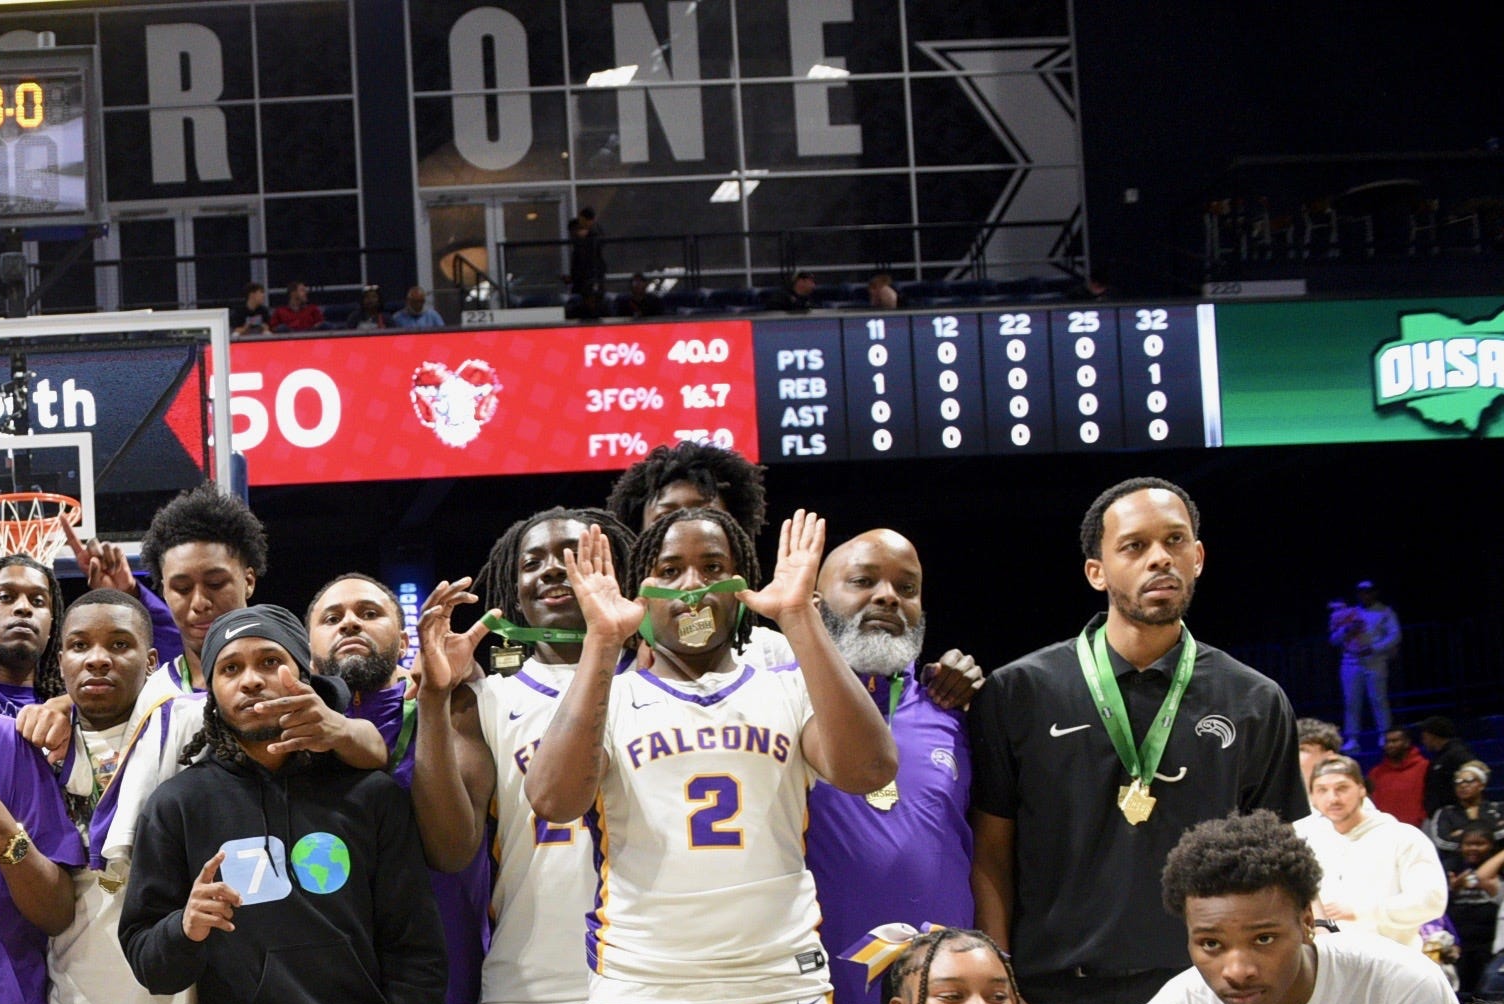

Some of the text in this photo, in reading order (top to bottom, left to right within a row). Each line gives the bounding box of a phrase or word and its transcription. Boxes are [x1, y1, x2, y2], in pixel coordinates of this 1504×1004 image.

[449, 0, 863, 170] ONE
[466, 310, 496, 325] 221
[866, 309, 1169, 340] 11 12 22 25 32
[585, 338, 729, 368] FG% 40.0
[777, 334, 1164, 371] PTS 0 0 0 0 0
[585, 383, 732, 412] 3FG% 16.7
[779, 362, 1161, 400] REB 1 0 0 0 1
[208, 369, 342, 452] 50
[781, 390, 1167, 427] AST 0 0 0 0 0
[588, 432, 648, 457] FT%
[782, 418, 1169, 456] FLS 0 0 0 0 0
[626, 723, 792, 771] FALCONS
[684, 772, 745, 851] 2
[236, 847, 269, 896] 7
